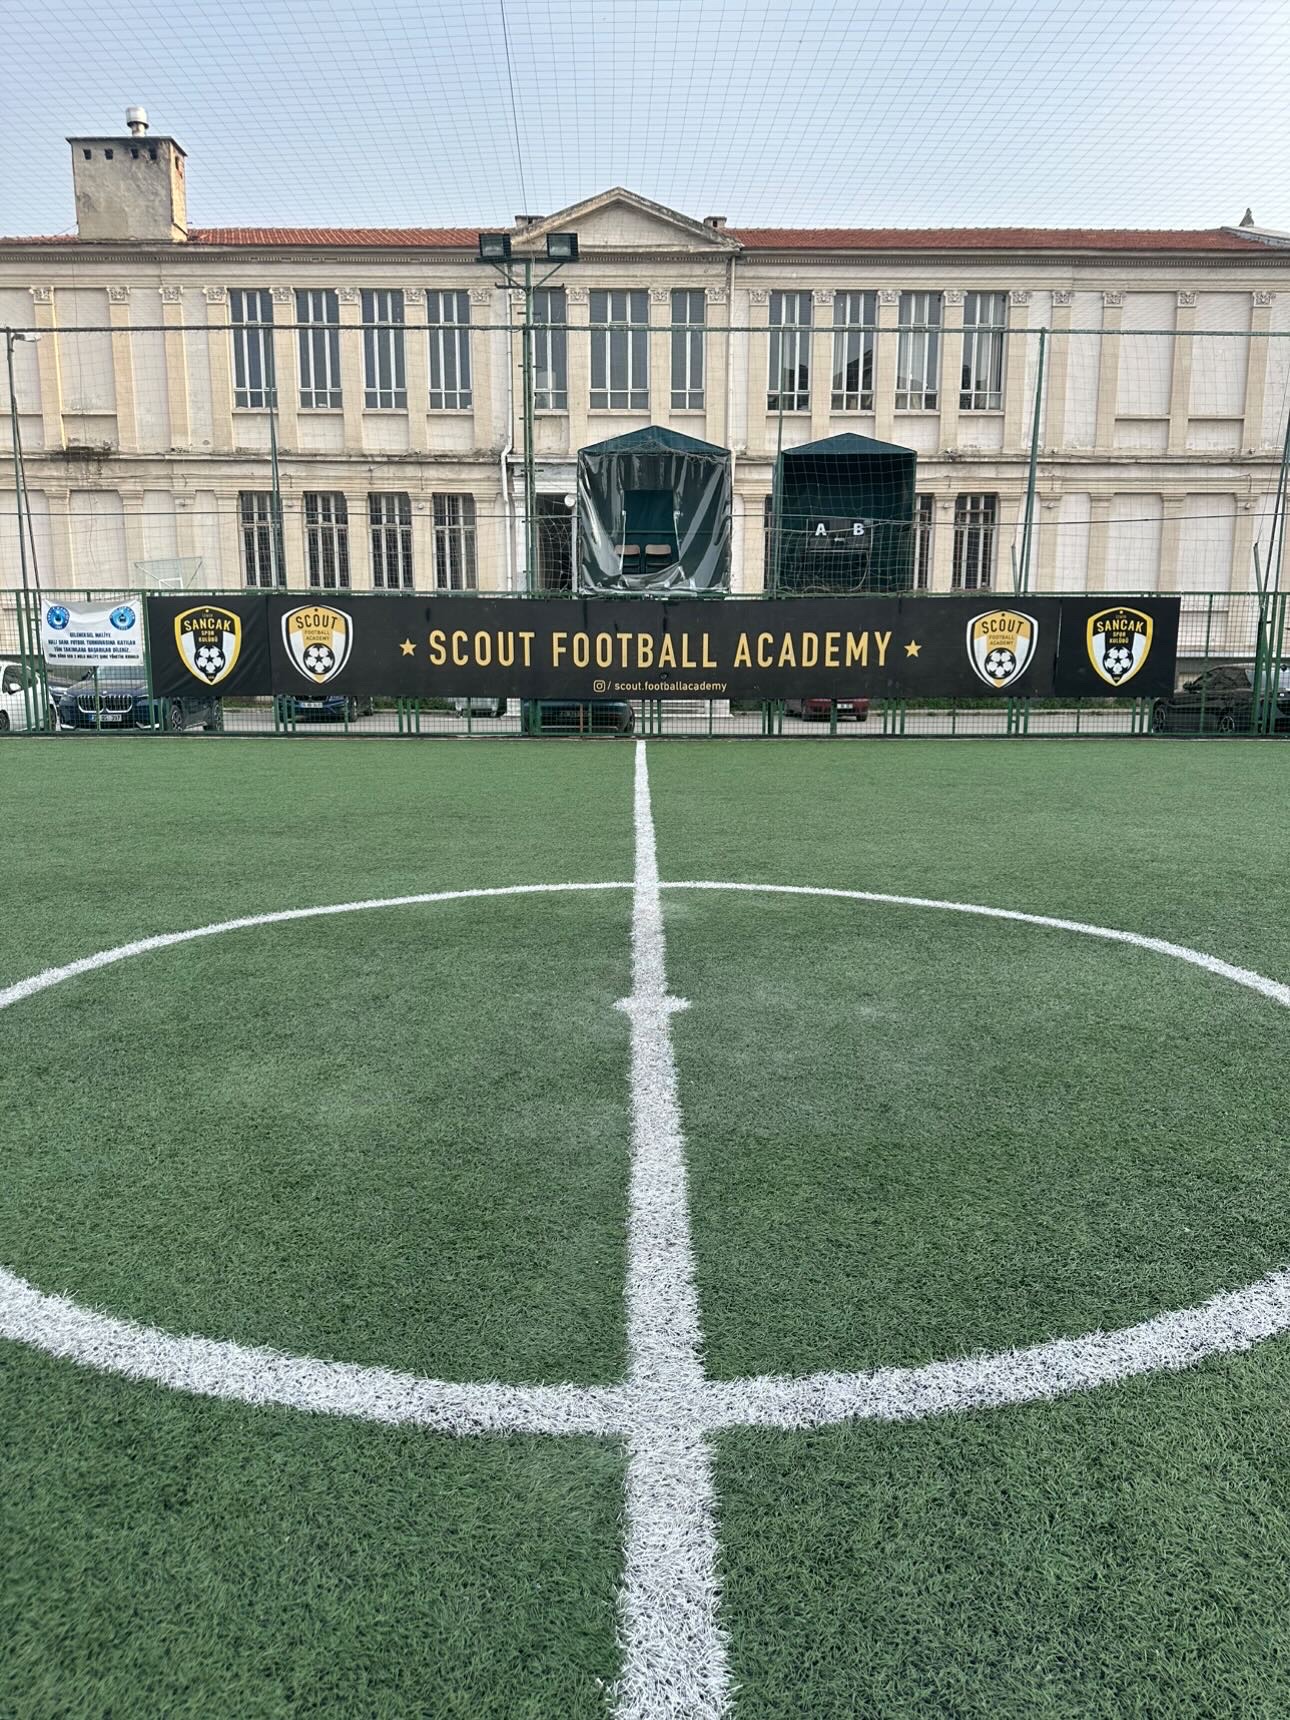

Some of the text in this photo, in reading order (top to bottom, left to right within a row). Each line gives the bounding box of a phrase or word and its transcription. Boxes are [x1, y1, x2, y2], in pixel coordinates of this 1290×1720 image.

[815, 523, 864, 536] A B
[184, 618, 231, 631] SANCAK
[296, 614, 338, 629] SCOUT
[982, 618, 1024, 634] SCOUT
[1097, 619, 1144, 632] SANCAK
[429, 629, 893, 669] SCOUT FOOTBALL ACADEMY
[614, 681, 728, 694] scout.footballacademy
